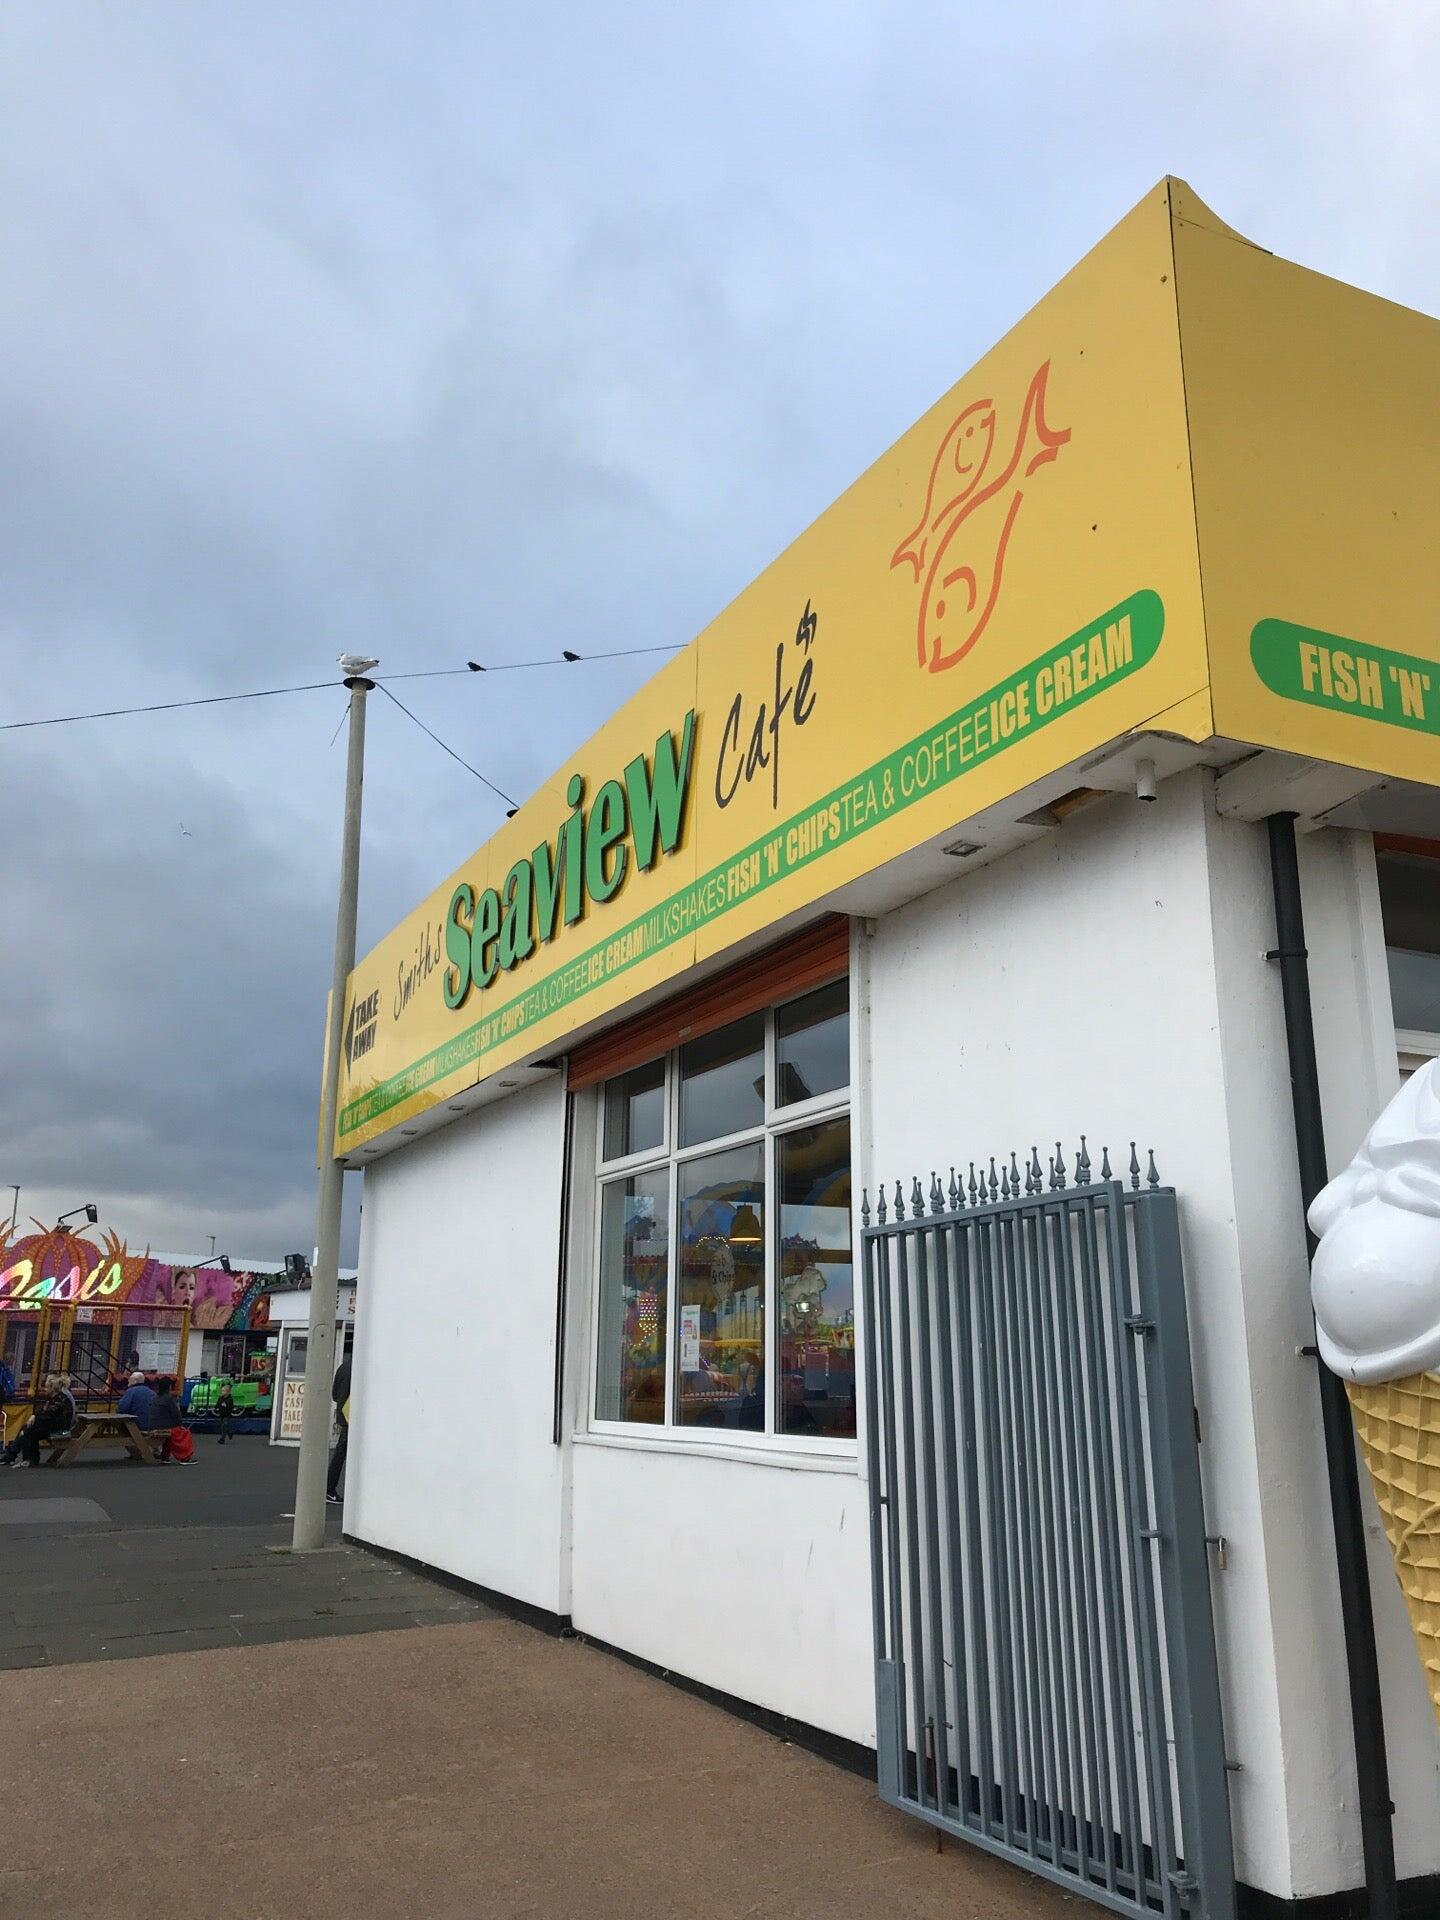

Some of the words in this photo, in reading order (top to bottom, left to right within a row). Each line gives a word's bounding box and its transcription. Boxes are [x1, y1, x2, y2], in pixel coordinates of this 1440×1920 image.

[1299, 641, 1384, 710] FISH
[1389, 666, 1431, 720] 'N'
[443, 708, 696, 1010] Seaview
[501, 1001, 525, 1036] CHIPS
[524, 995, 541, 1020] TEA
[541, 992, 548, 1012] &
[549, 959, 588, 1006] COFFEE
[587, 953, 605, 987] ICE
[605, 925, 643, 972] CREAM
[643, 874, 726, 952] MILKSHAKES
[726, 857, 762, 902] FISH
[785, 806, 842, 867] CHIPS
[841, 784, 879, 834] TEA
[882, 769, 895, 810] &
[900, 706, 991, 799] COFFEE
[989, 689, 1031, 745] ICE
[1035, 615, 1134, 715] CREAM
[352, 1020, 377, 1063] AWAY
[355, 989, 379, 1031] TAKE
